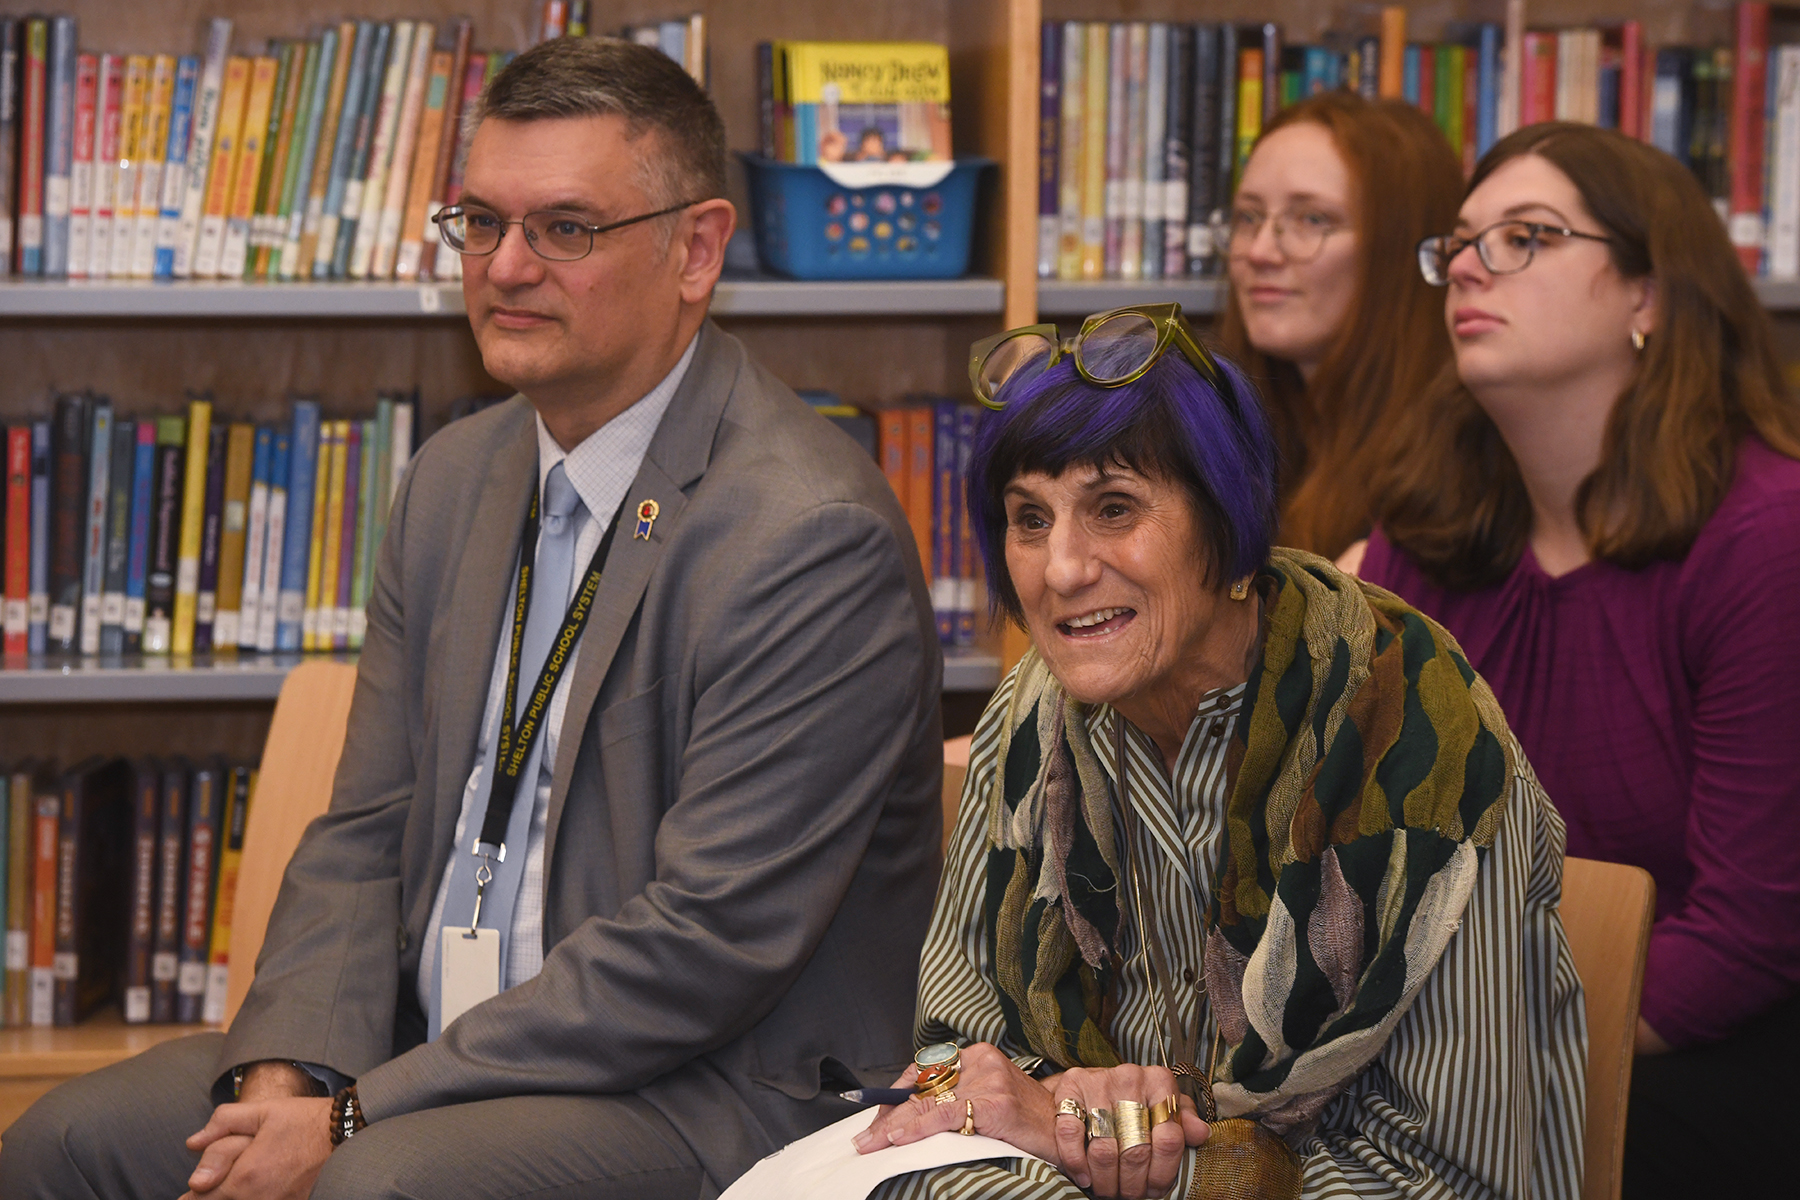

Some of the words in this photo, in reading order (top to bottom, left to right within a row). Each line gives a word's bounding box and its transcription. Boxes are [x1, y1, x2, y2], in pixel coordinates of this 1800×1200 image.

[516, 565, 530, 622] SHELTON
[506, 720, 536, 777] SHELTON
[529, 673, 555, 719] PUBLIC
[549, 622, 580, 673] SCHOOL
[572, 571, 603, 621] SYSTEM
[510, 624, 522, 669] PUBLIC
